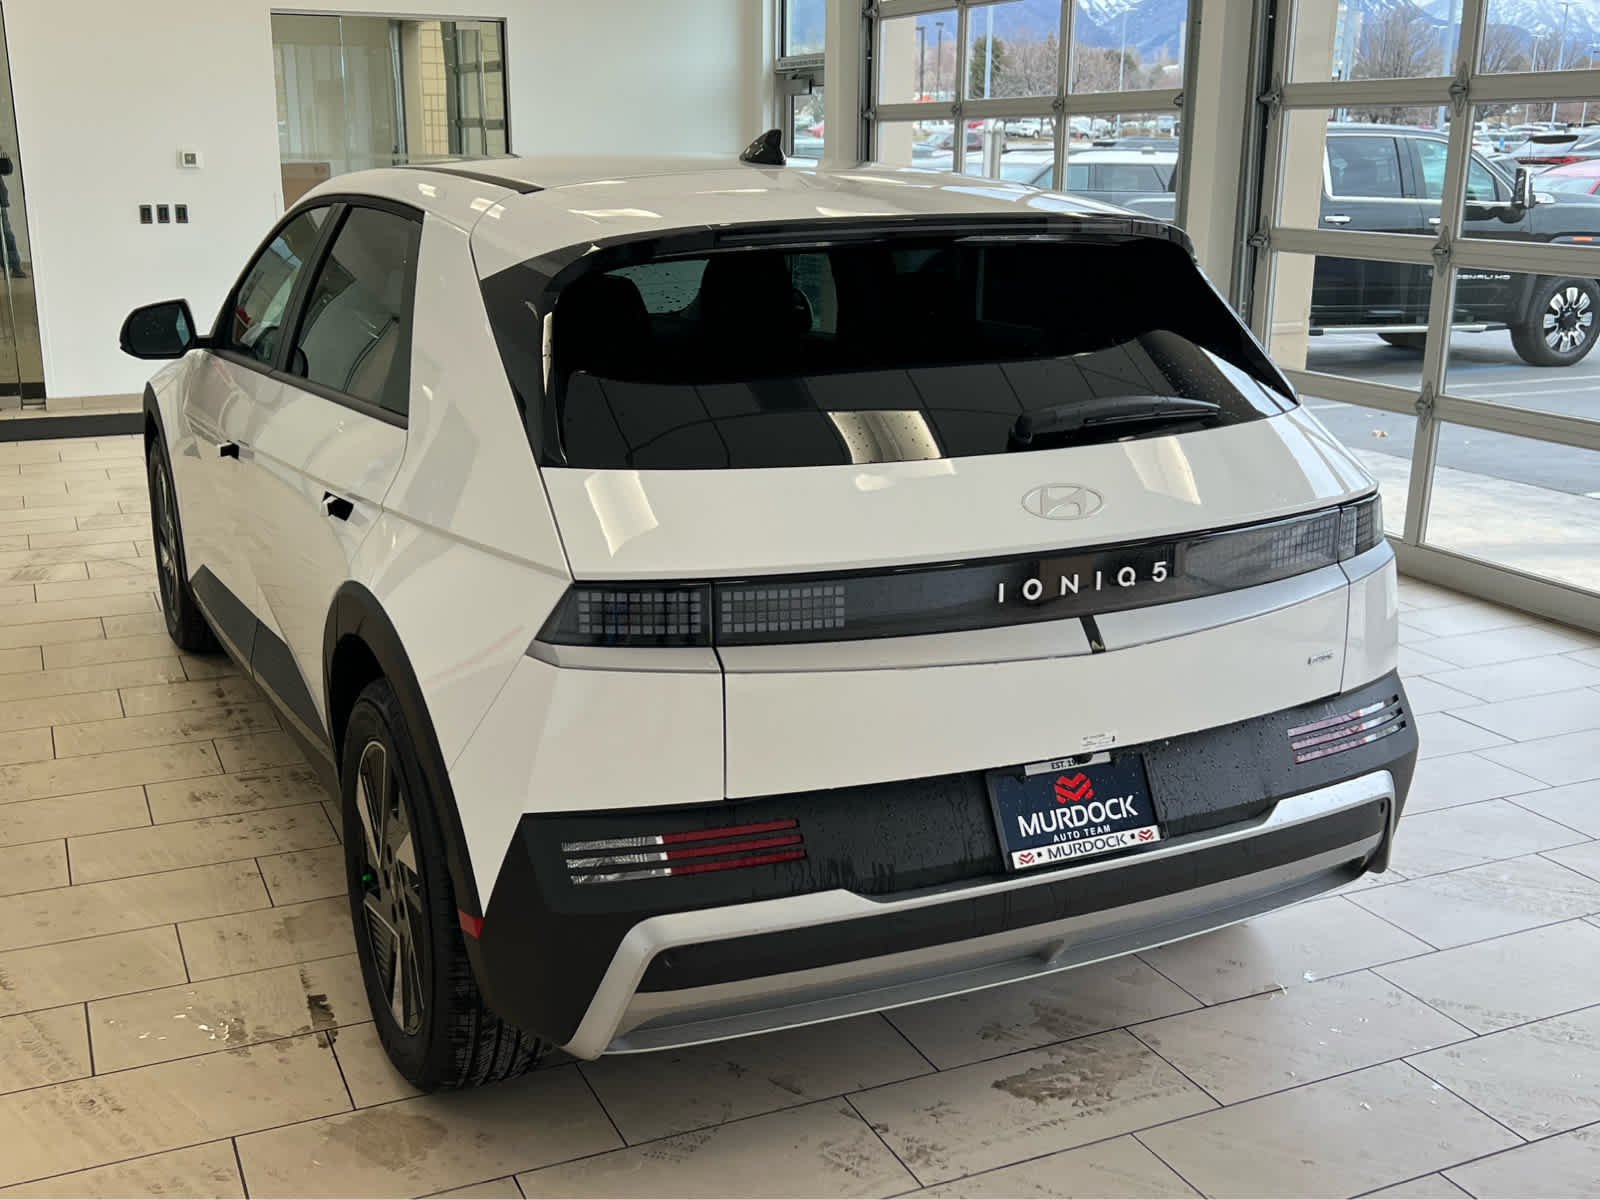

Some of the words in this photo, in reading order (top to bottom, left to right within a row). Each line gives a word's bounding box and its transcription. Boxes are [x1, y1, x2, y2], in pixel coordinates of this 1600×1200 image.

[1017, 794, 1139, 838] MURDOCK
[1047, 833, 1128, 860] MURDOCK
[1053, 830, 1081, 843] AUTO
[1083, 824, 1111, 837] TEAM
